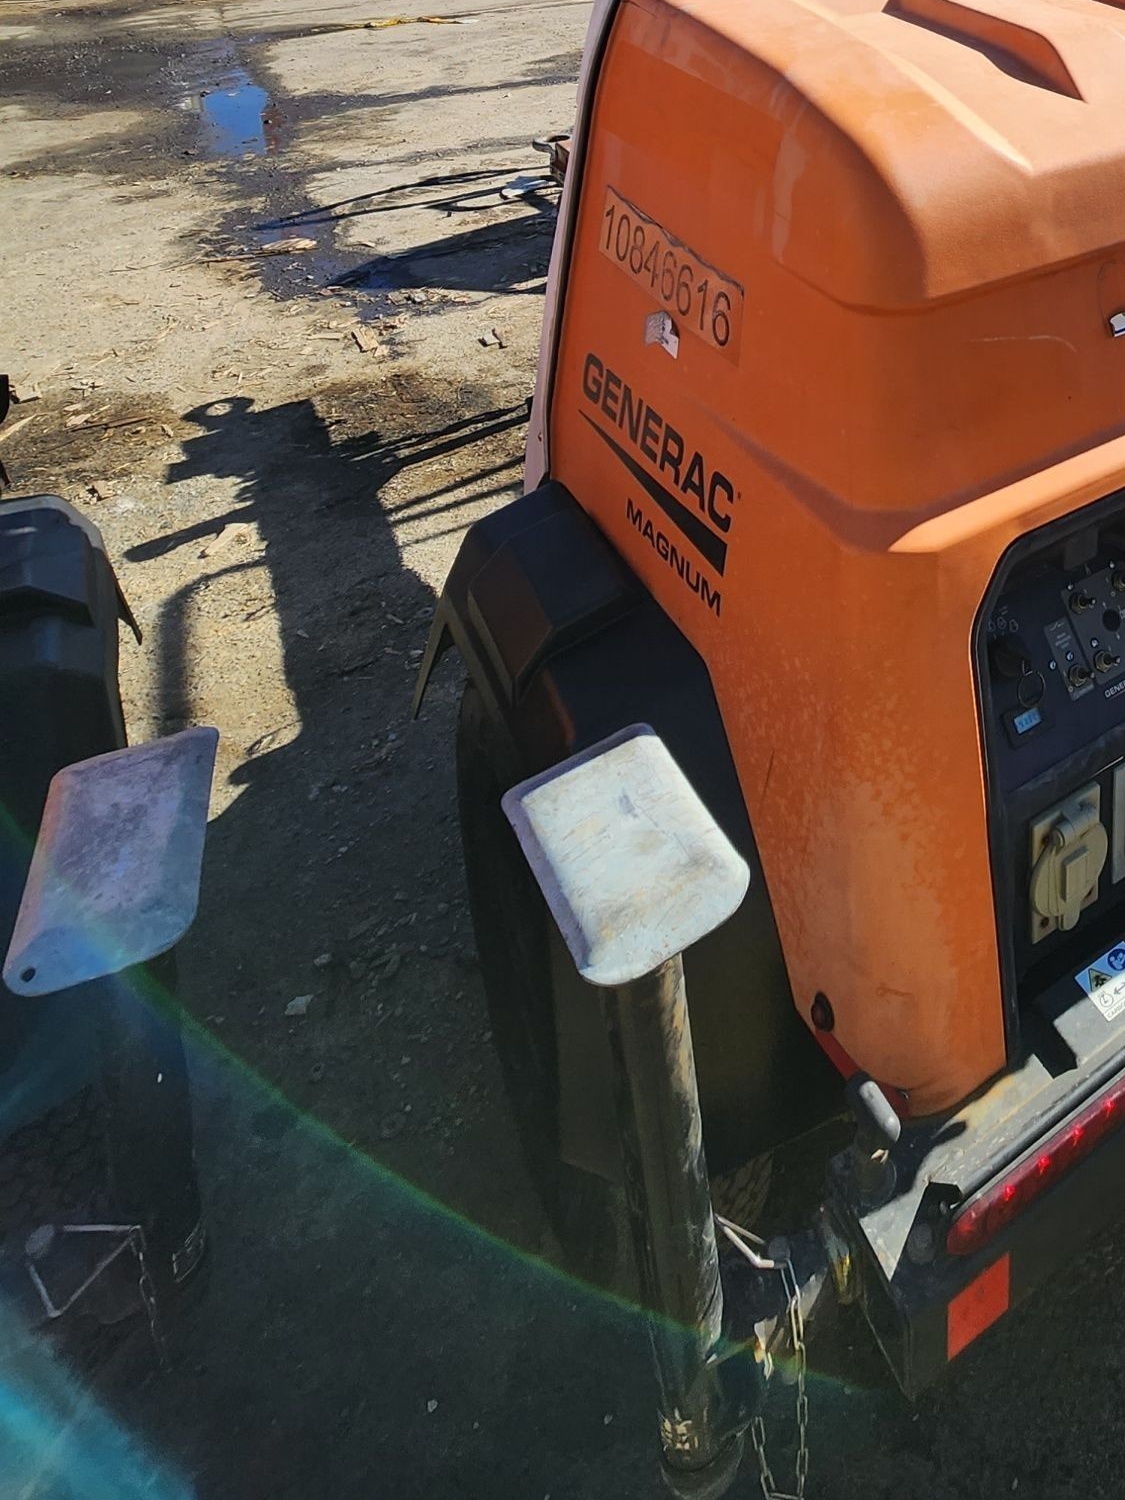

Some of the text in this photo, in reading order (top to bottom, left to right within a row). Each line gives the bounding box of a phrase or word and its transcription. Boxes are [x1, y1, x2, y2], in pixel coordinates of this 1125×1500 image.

[604, 204, 731, 347] 10846616
[582, 352, 735, 534] GENERAC
[626, 497, 722, 618] MAGNUM
